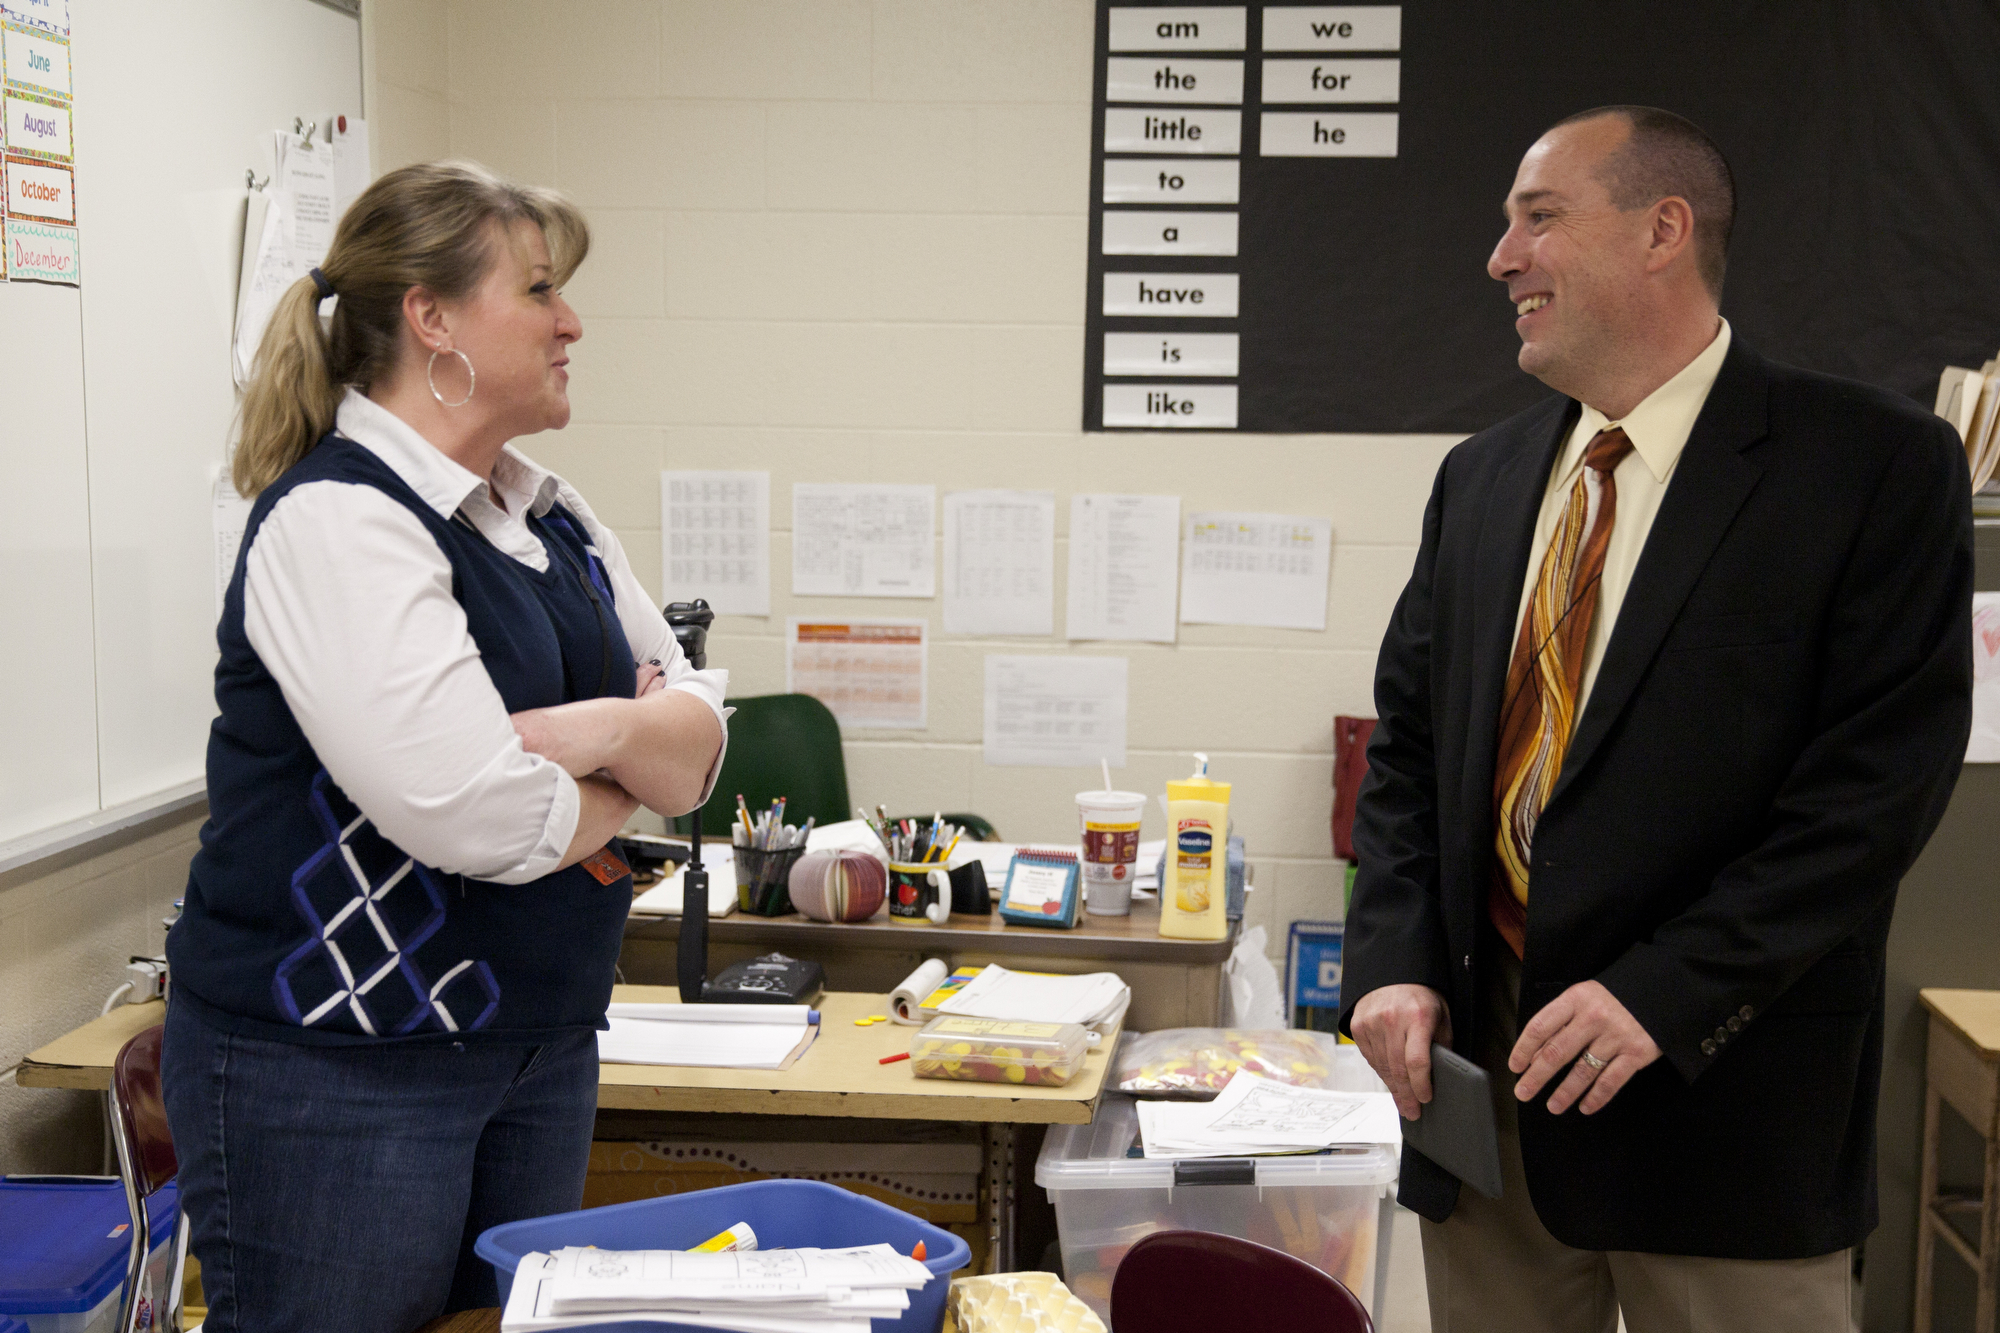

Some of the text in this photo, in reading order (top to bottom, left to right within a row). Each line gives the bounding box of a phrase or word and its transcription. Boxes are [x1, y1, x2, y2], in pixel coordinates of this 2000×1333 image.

[1156, 22, 1199, 38] am
[1311, 21, 1353, 38] we
[28, 49, 50, 73] June
[1154, 65, 1196, 90] the
[1311, 66, 1351, 91] for
[24, 112, 57, 138] August
[1144, 116, 1202, 140] little
[1313, 119, 1346, 144] he
[21, 179, 61, 203] October
[1158, 171, 1185, 191] to
[1162, 226, 1179, 243] a
[15, 238, 70, 271] December
[1138, 280, 1204, 304] have
[1161, 340, 1181, 363] is
[1146, 391, 1195, 415] like
[1178, 837, 1211, 847] Vaseline
